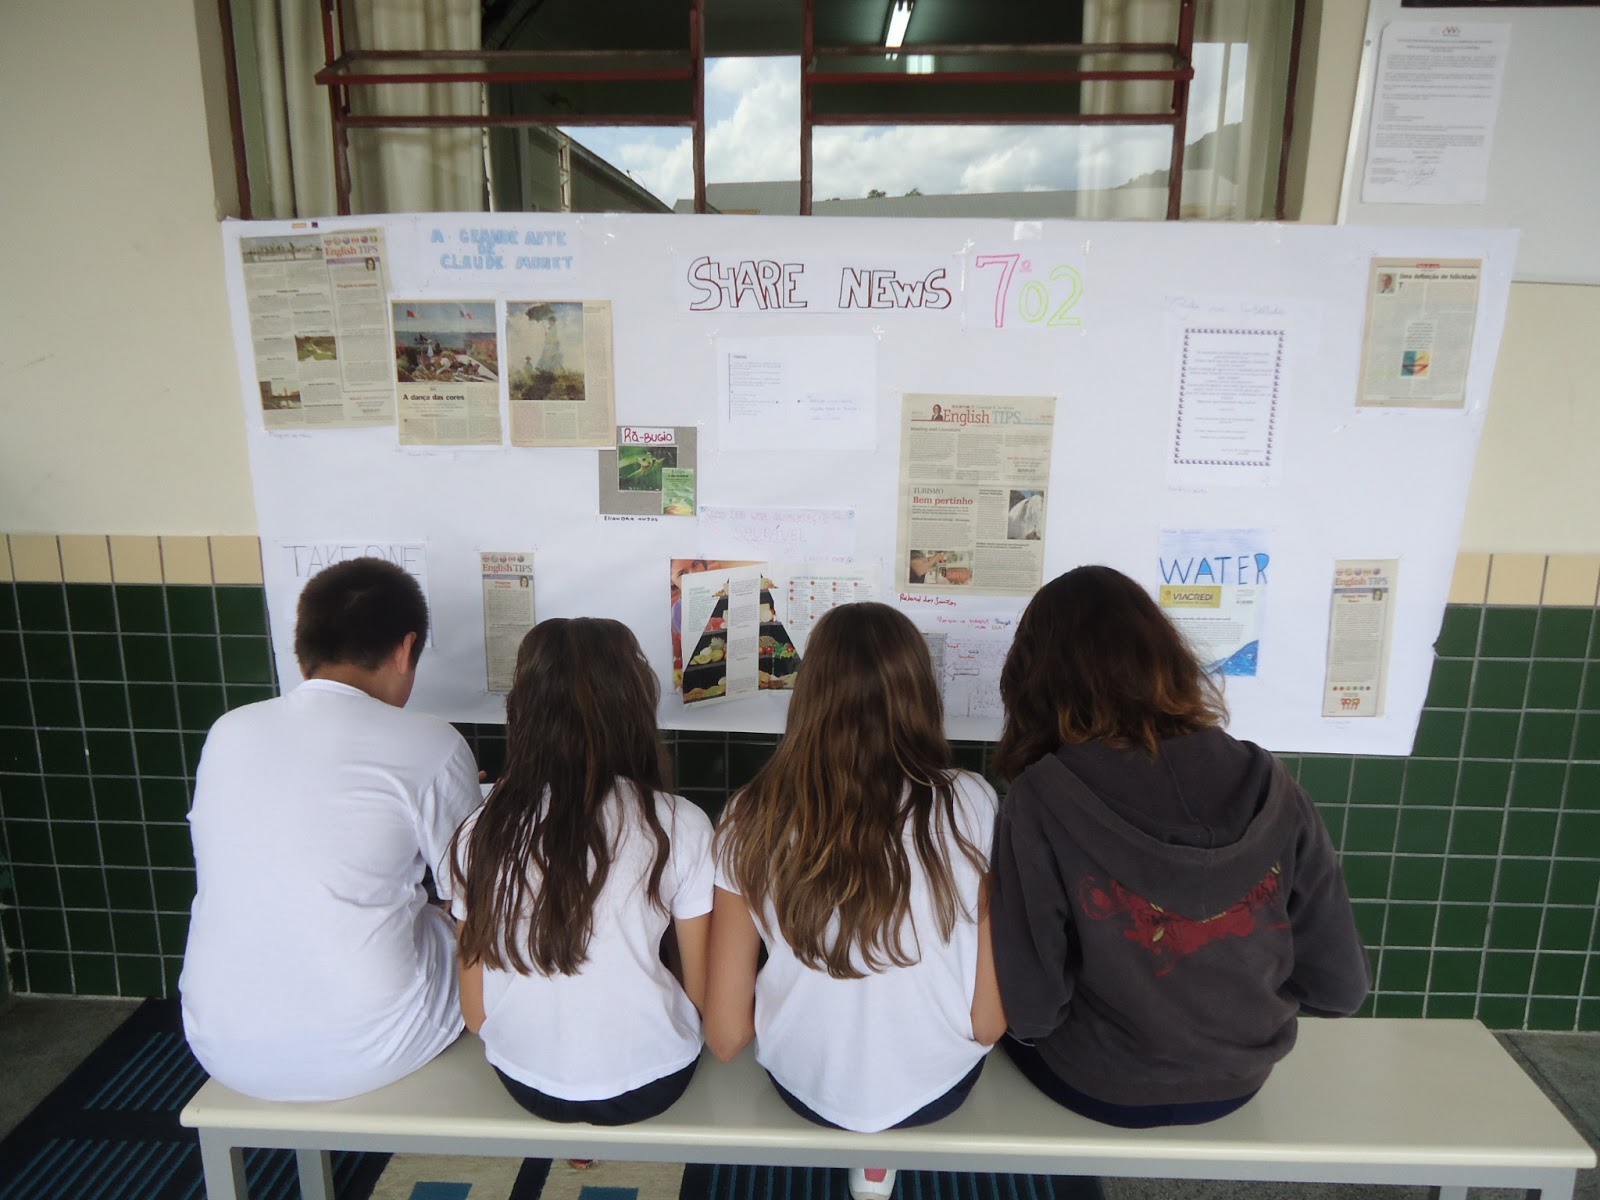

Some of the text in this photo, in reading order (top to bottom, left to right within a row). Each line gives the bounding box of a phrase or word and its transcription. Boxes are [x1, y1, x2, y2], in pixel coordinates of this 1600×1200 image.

[431, 228, 567, 246] A GRANDE ARTE
[325, 246, 357, 256] English
[440, 253, 504, 269] CLAUDE
[687, 256, 952, 311] SHARE NEWS
[411, 394, 430, 402] dança
[943, 409, 1022, 426] English TIPS
[912, 496, 974, 506] Bem pertinho
[482, 562, 533, 573] English TIPS
[1159, 552, 1270, 586] WATER
[1335, 577, 1366, 587] English
[1173, 593, 1214, 601] VIACREDI
